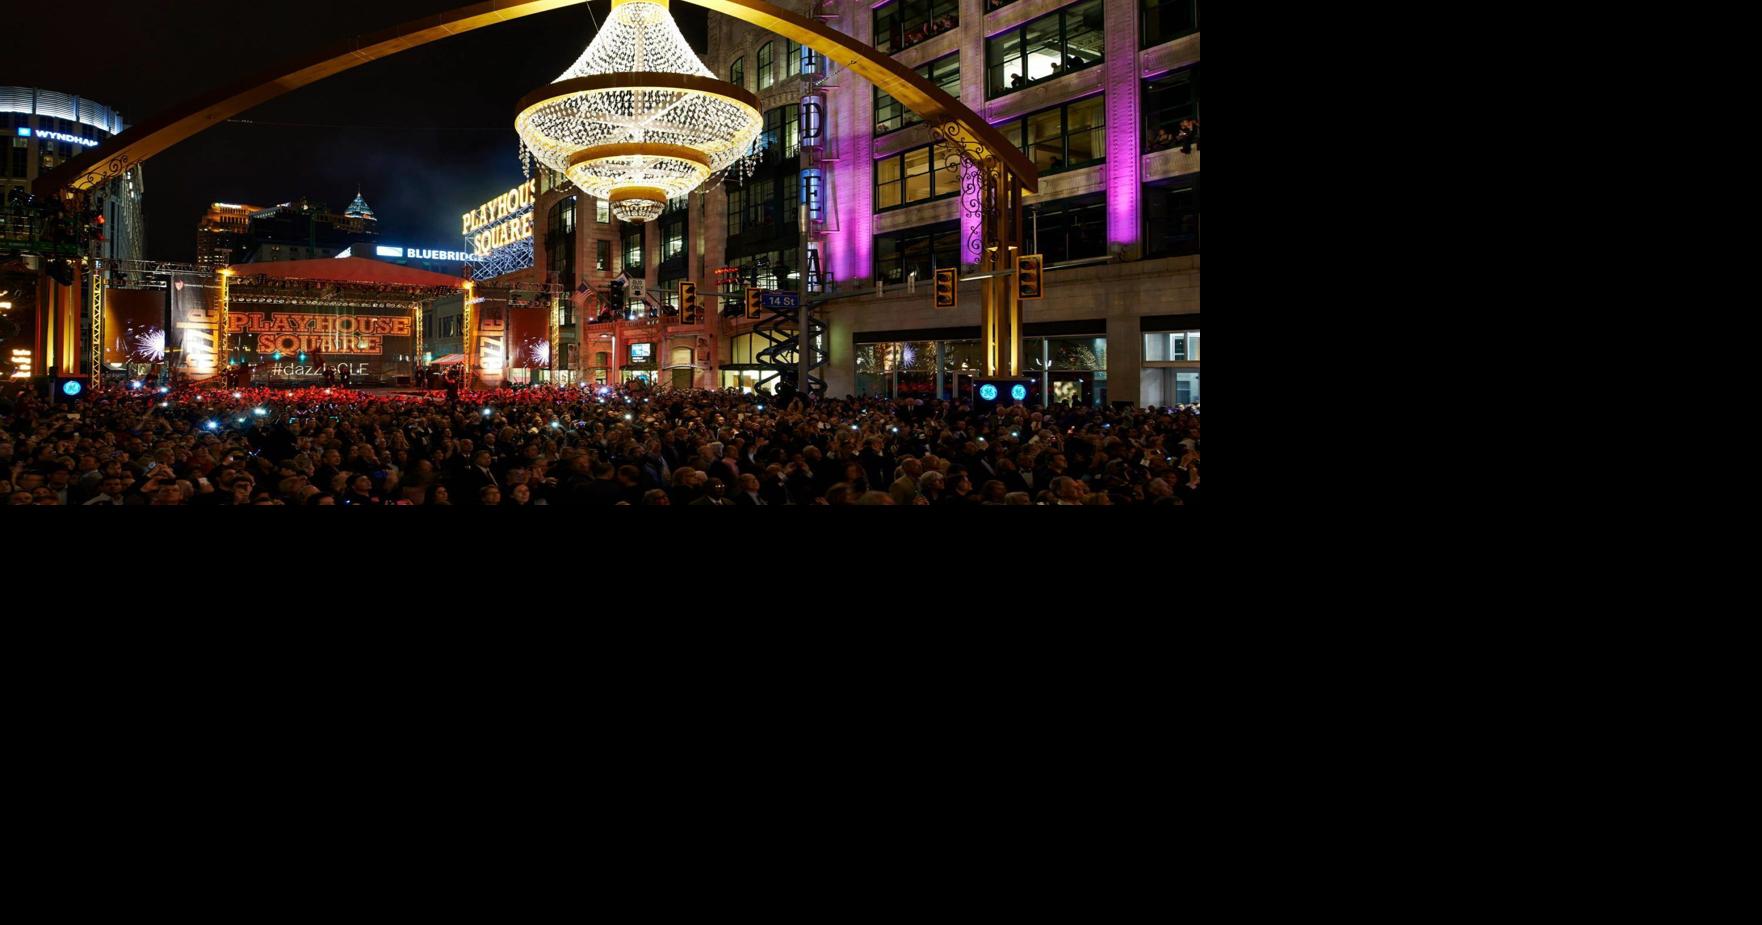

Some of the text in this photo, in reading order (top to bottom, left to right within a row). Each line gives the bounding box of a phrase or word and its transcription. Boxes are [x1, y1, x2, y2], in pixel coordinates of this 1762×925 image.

[36, 130, 98, 146] WYNDHAM
[474, 211, 534, 256] SQUARE
[768, 296, 796, 306] 14 St
[227, 312, 412, 336] PLAYHOUSE
[257, 333, 383, 356] SQUARE
